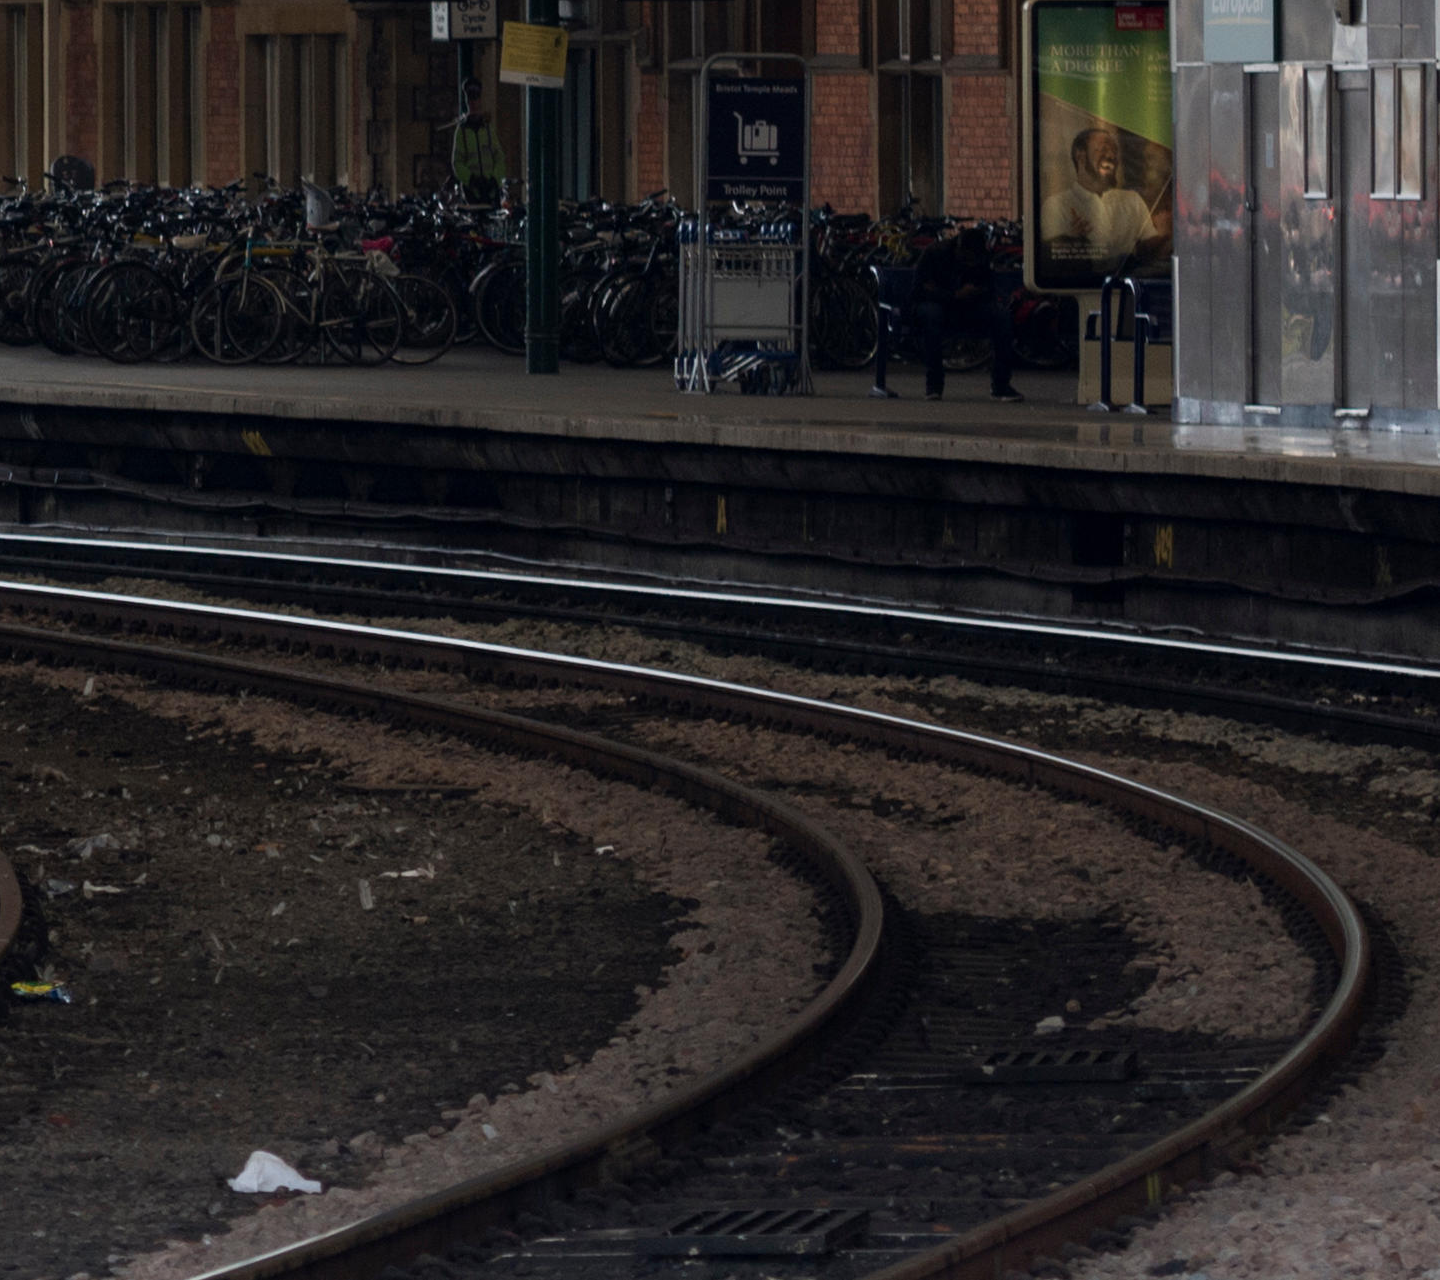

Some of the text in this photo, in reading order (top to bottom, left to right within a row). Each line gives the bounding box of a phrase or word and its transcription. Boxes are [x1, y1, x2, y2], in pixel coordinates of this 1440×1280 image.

[1050, 43, 1141, 57] MORE THAN
[1051, 60, 1124, 73] A DEGREE
[723, 183, 788, 197] Trolley Point
